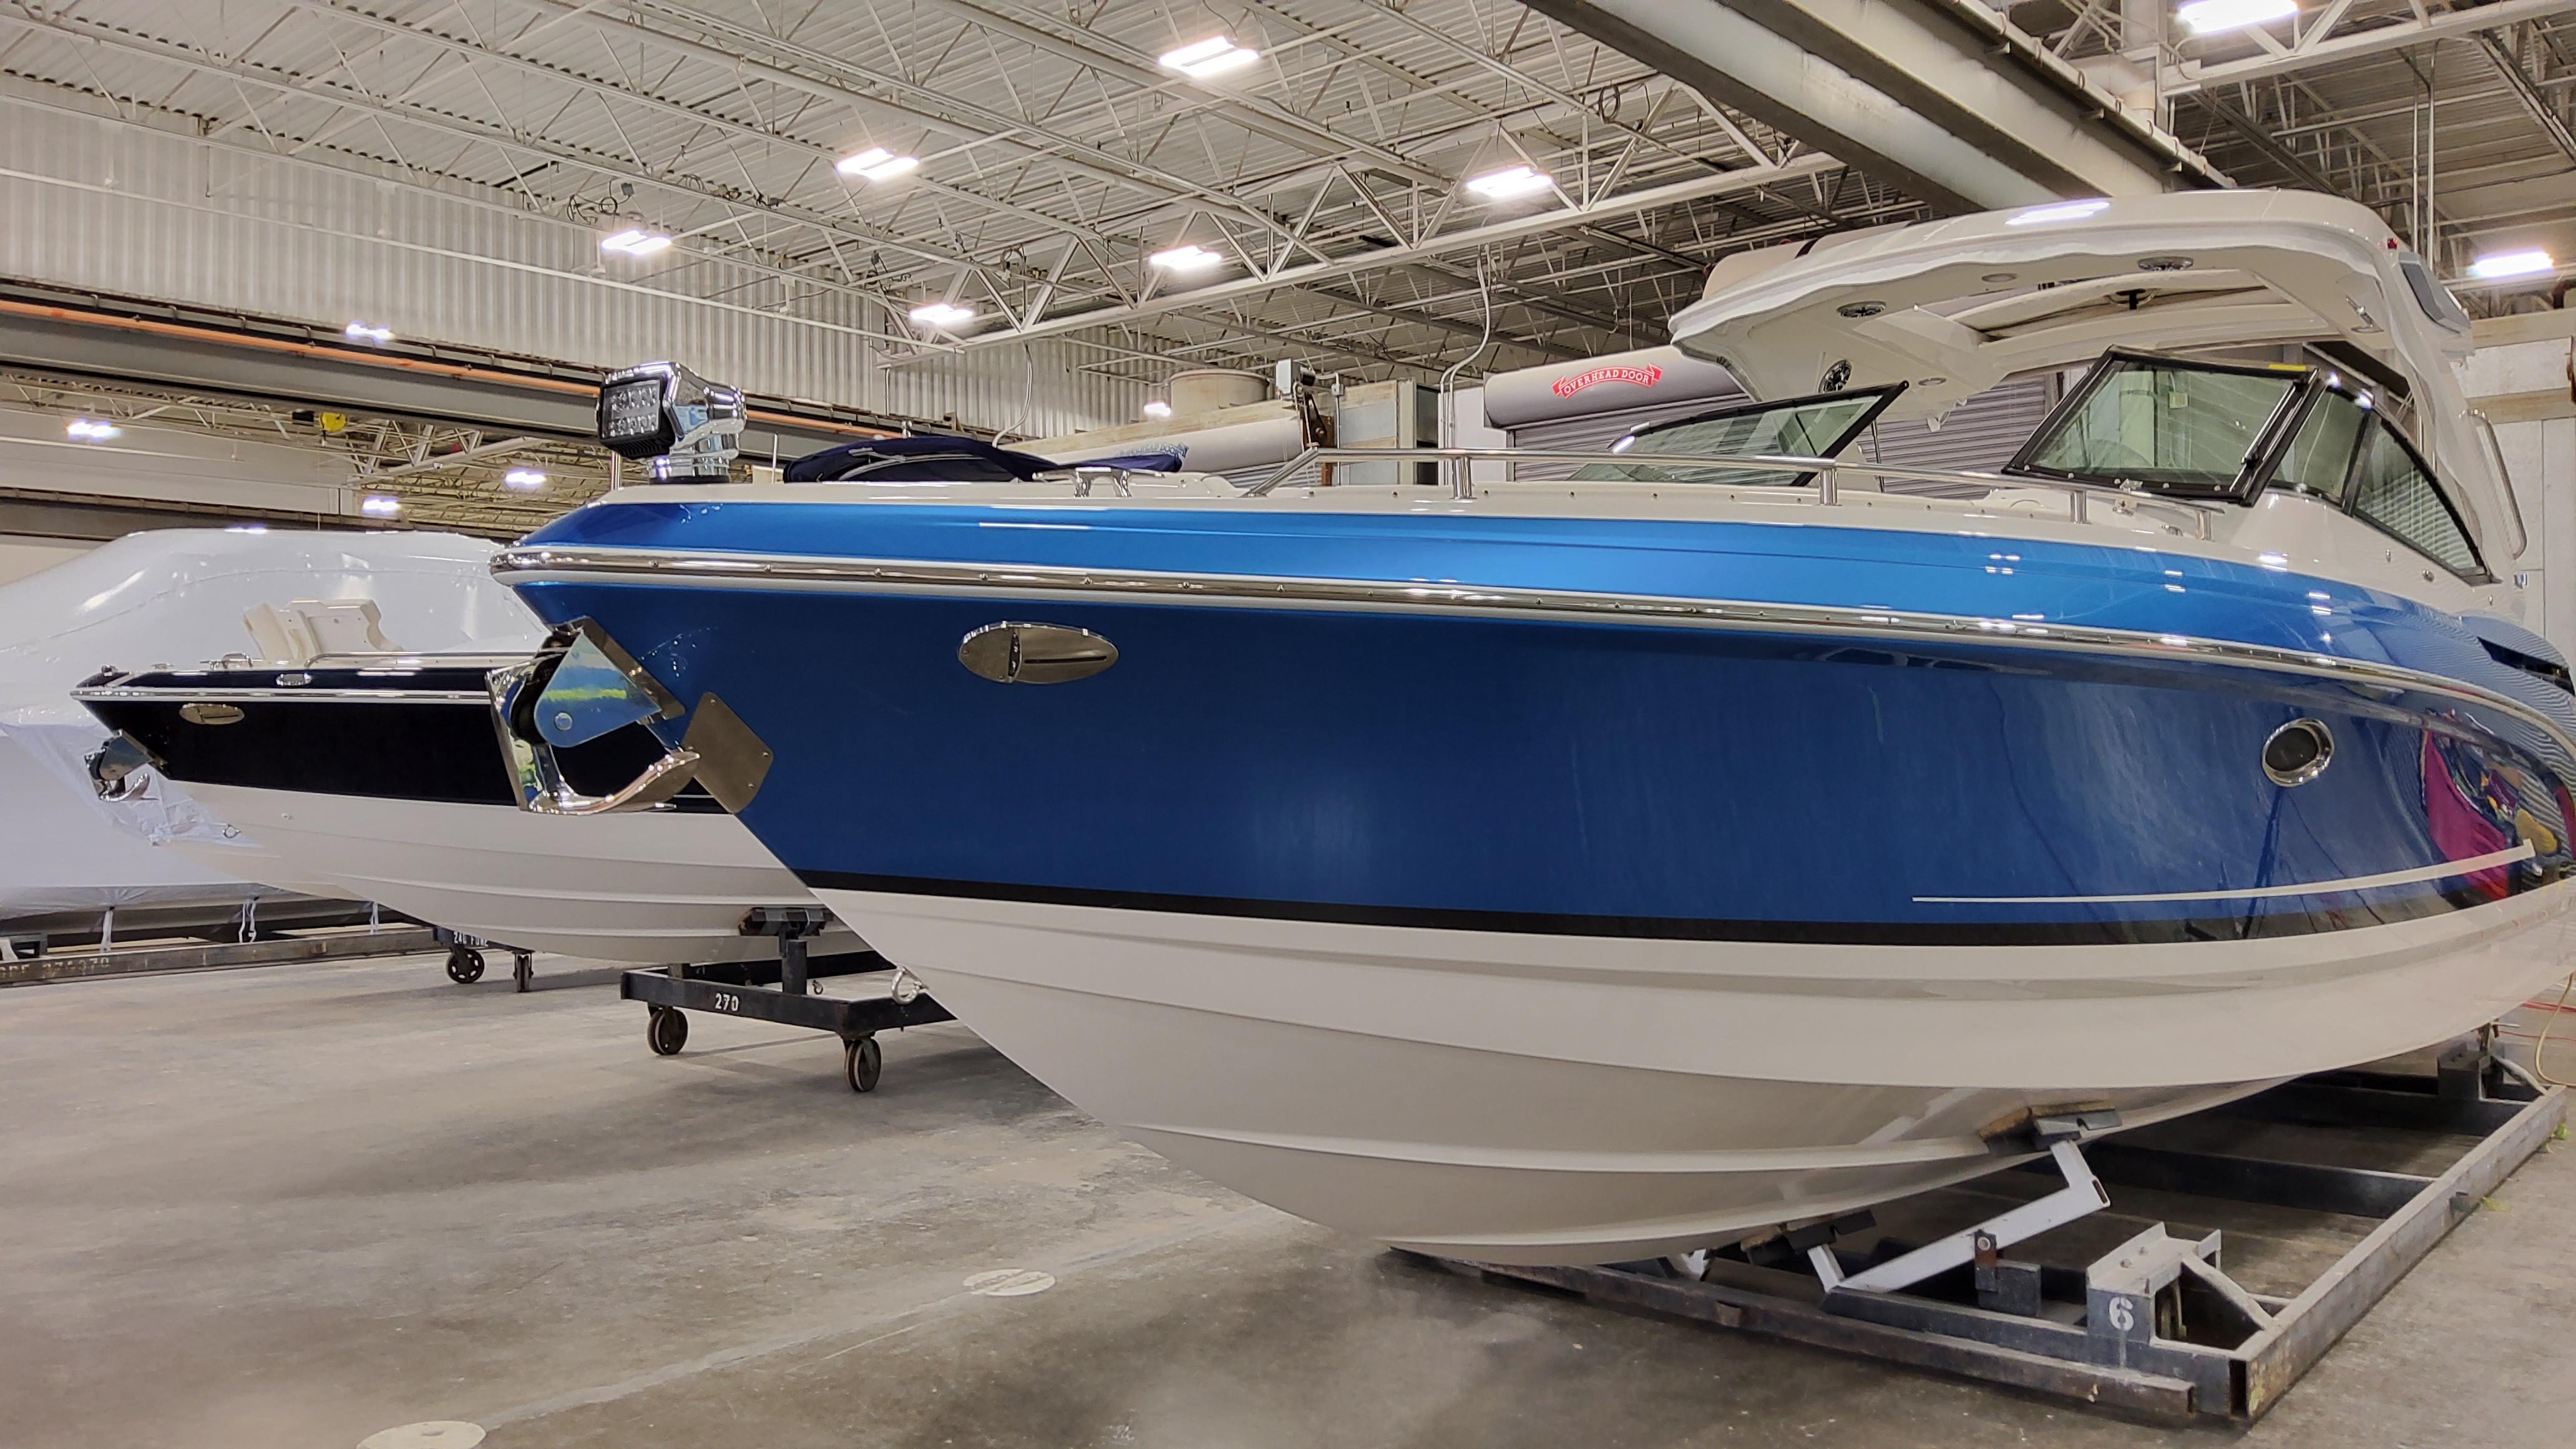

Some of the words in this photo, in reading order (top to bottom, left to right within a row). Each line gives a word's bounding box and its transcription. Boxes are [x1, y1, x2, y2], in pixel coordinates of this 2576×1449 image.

[1564, 369, 1619, 394] OVERHEAD
[1621, 369, 1649, 384] DOOR
[715, 993, 739, 1012] 270
[2109, 1297, 2134, 1331] 6
